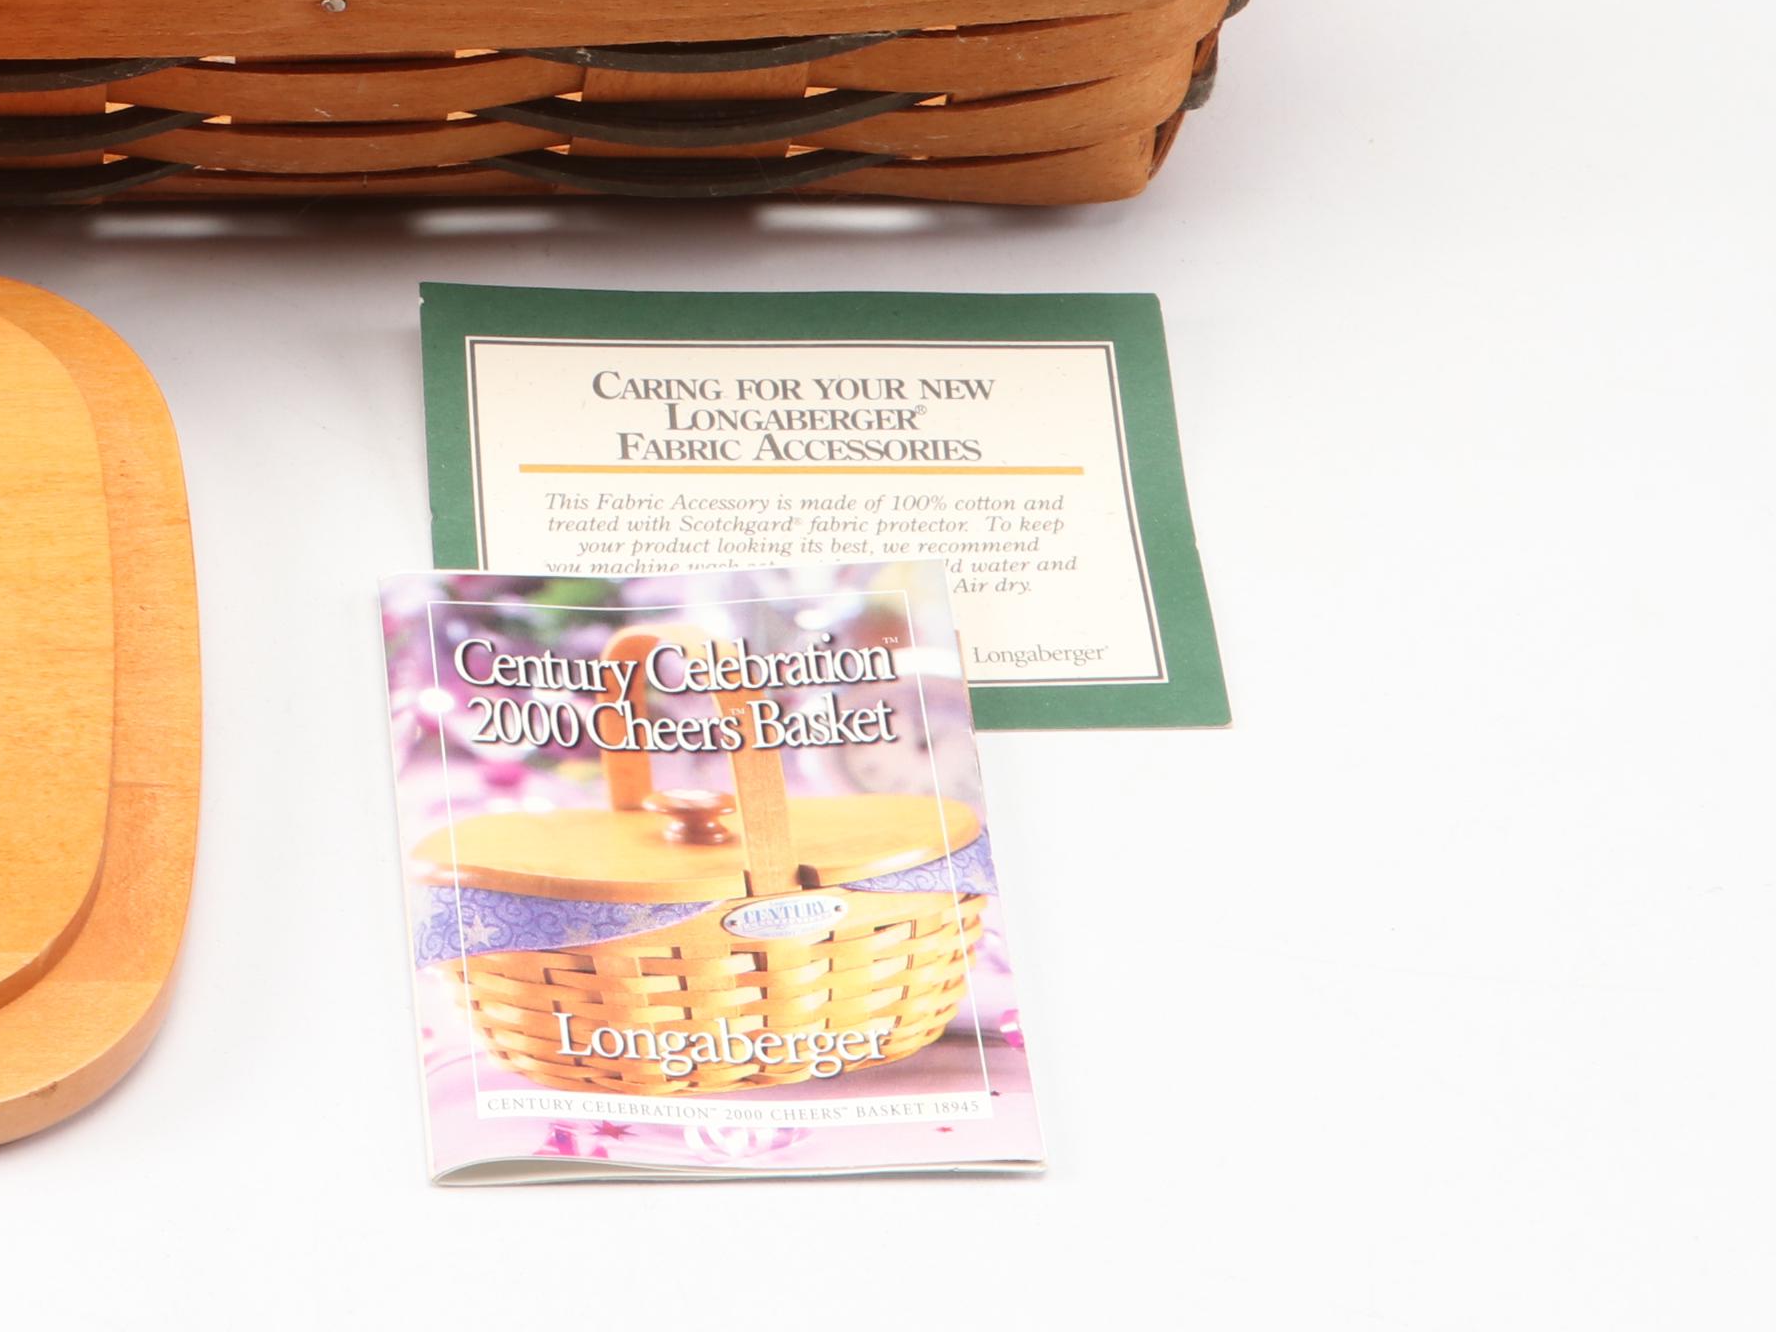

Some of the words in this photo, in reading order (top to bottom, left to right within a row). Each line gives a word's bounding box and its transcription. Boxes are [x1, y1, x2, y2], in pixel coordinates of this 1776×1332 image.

[591, 370, 723, 400] CARING
[736, 378, 802, 401] FOR
[812, 378, 908, 401] YOUR
[918, 378, 996, 401] NEW
[617, 432, 742, 461] FABRIC
[752, 432, 983, 461] ACCESSORIES
[545, 492, 590, 511] This
[595, 492, 665, 511] Fabric
[670, 493, 770, 514] Accessory
[776, 493, 793, 511] is
[800, 493, 857, 512] made
[864, 493, 887, 514] of
[891, 494, 948, 512] 100%
[954, 494, 1017, 512] cotton
[1023, 494, 1065, 512] and
[547, 515, 620, 533] treated
[627, 515, 672, 533] with
[807, 515, 869, 536] fabric
[875, 516, 969, 536] protector.
[985, 515, 1012, 533] To
[1019, 516, 1065, 535] keep
[576, 539, 625, 557] your
[630, 537, 711, 557] product
[716, 537, 794, 557] looking
[800, 537, 823, 554] its
[830, 537, 875, 556] best,
[882, 541, 911, 554] we
[917, 536, 1041, 554] recommend
[970, 559, 1031, 574] water
[1036, 555, 1078, 572] and
[952, 577, 989, 594] Air
[994, 577, 1032, 595] dry.
[453, 637, 638, 704] Century
[466, 697, 581, 749] 2000
[747, 693, 898, 750] Basket
[552, 1010, 893, 1079] Longaberger
[487, 1097, 574, 1112] CENTURY
[726, 1108, 763, 1121] 2000
[856, 1102, 925, 1118] BASKET
[933, 1099, 980, 1115] 18945
